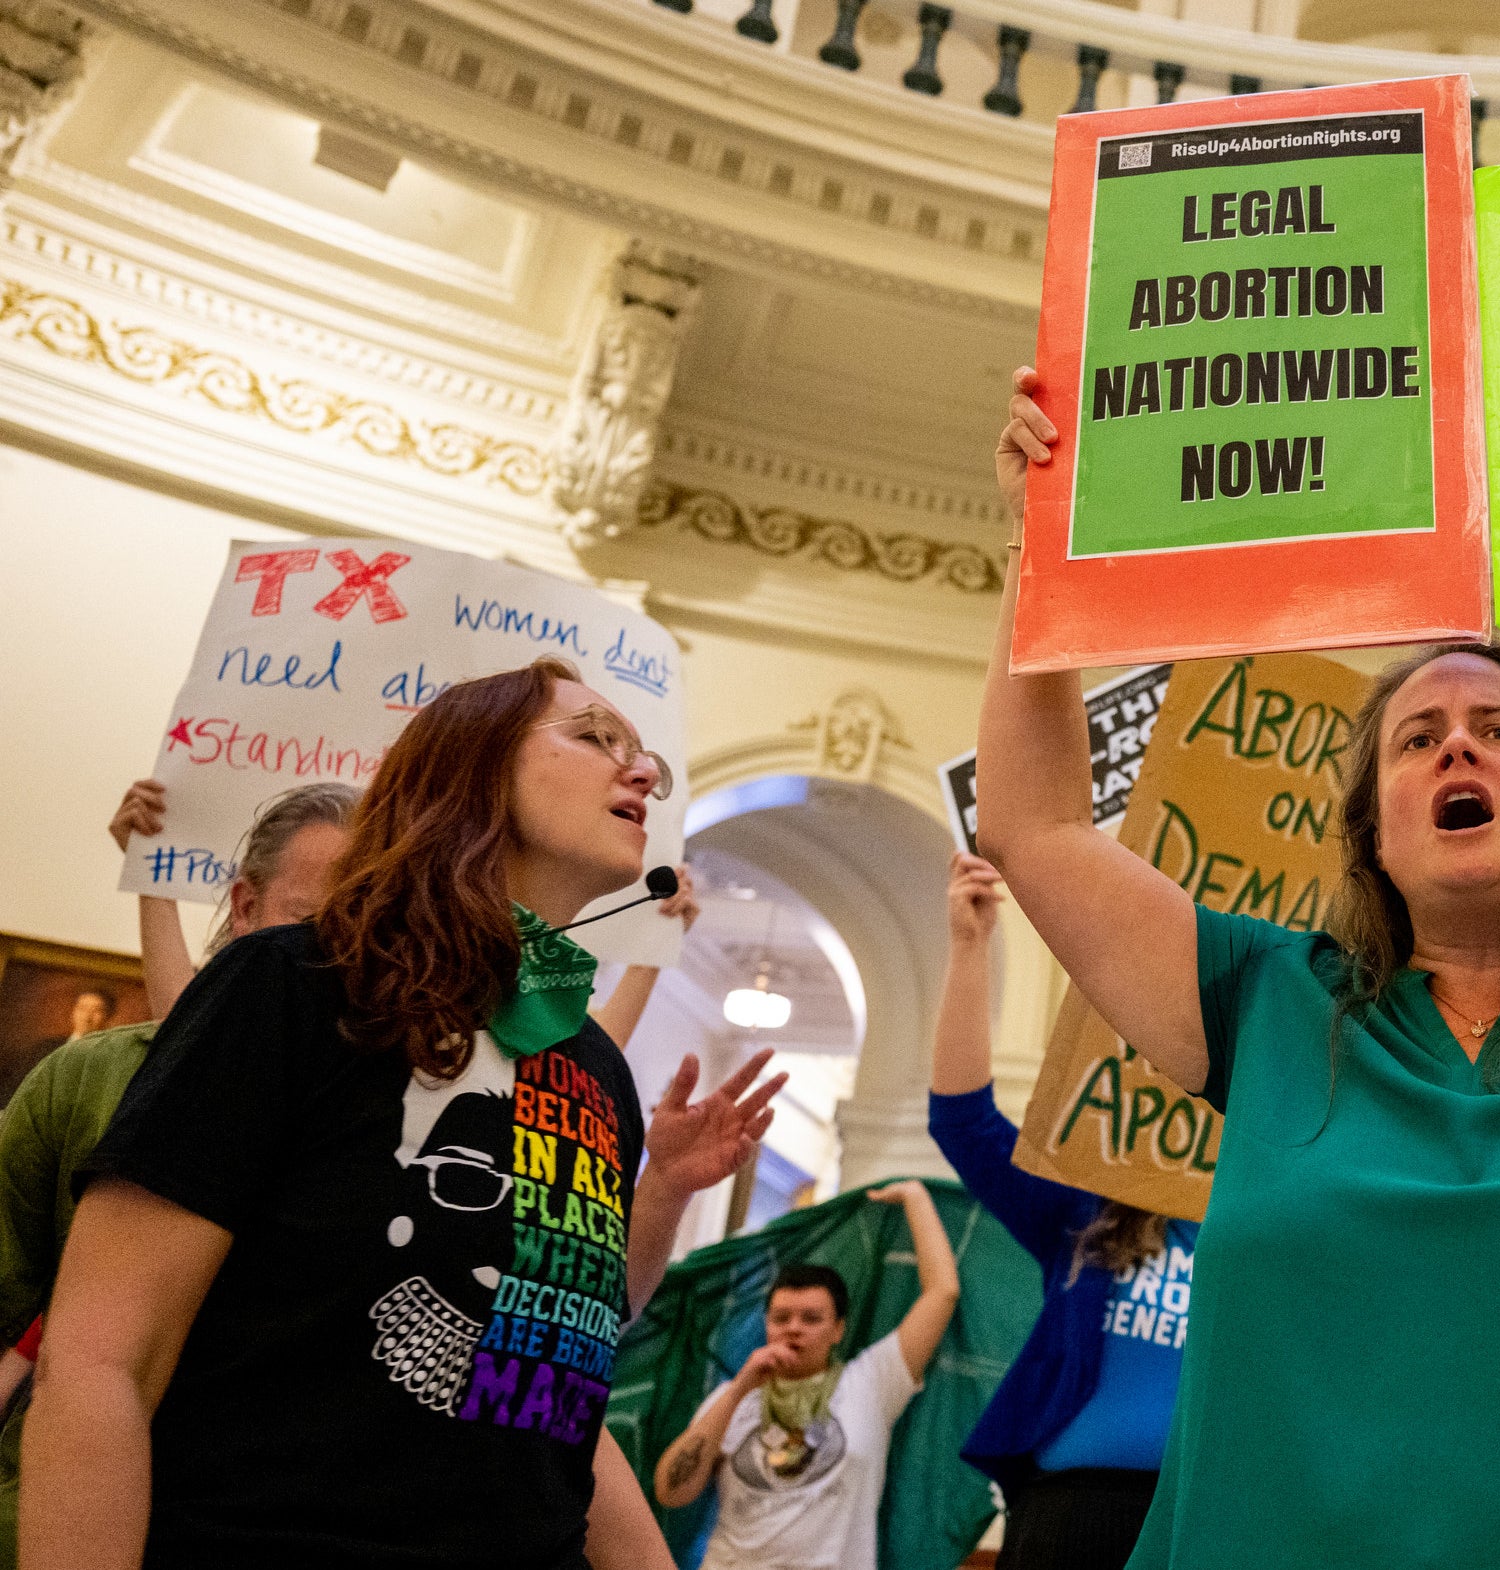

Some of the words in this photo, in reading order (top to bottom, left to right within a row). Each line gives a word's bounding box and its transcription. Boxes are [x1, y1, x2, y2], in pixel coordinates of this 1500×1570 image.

[1172, 126, 1401, 158] RiseUp4AbortionRights.org
[1182, 184, 1336, 243] LEGAL
[1129, 265, 1384, 330] ABORTION
[1092, 346, 1421, 421] NATIONWIDE
[1180, 436, 1325, 502] NOW!
[235, 549, 411, 624] TX
[217, 640, 342, 693] need
[382, 662, 451, 706] ab
[1267, 791, 1332, 844] ON
[1058, 1055, 1218, 1172] APOL
[512, 1125, 558, 1185] IN
[479, 1314, 549, 1358] ARE
[491, 1275, 620, 1347] DECISIONS
